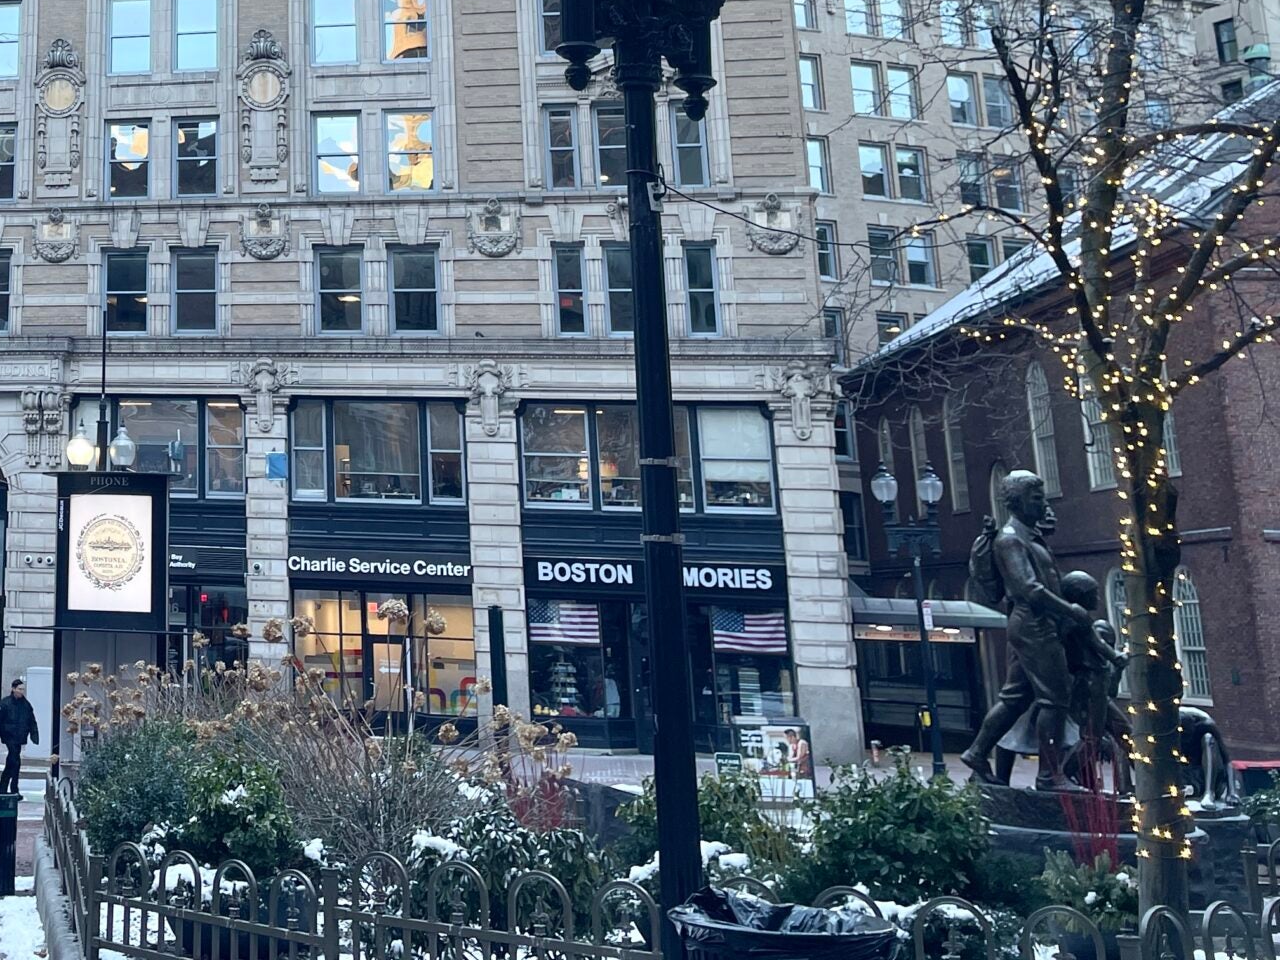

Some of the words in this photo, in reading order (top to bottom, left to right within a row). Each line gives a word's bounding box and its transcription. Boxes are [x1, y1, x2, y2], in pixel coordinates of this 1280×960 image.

[90, 477, 129, 486] PHONE
[288, 556, 346, 573] Charlie
[349, 558, 410, 576] Service
[413, 560, 470, 577] Center
[537, 561, 634, 584] BOSTON
[683, 567, 773, 590] MORIES
